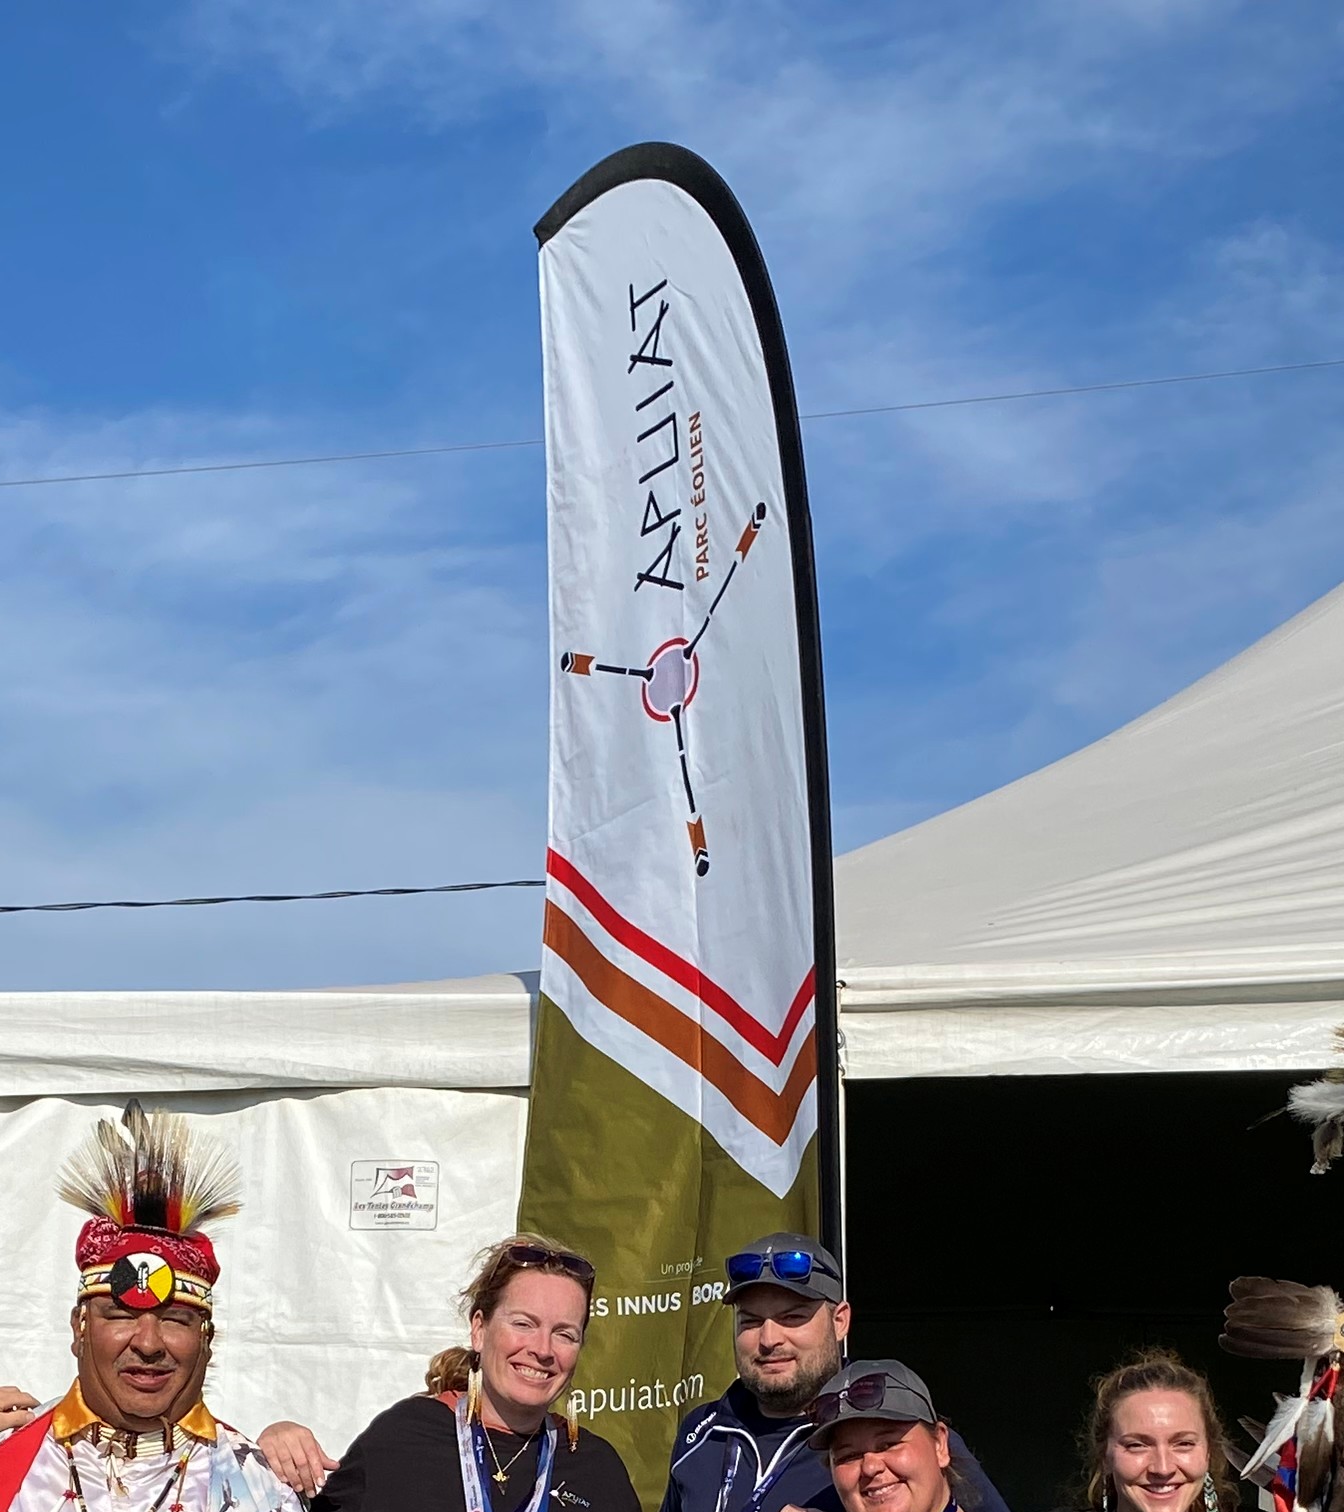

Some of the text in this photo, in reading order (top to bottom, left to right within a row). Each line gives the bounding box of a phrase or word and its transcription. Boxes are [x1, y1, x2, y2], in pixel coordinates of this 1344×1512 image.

[628, 279, 684, 592] APUIAT
[688, 411, 710, 583] PARC ÉOLIEN
[617, 1292, 682, 1316] INNUS
[660, 1263, 674, 1276] Un
